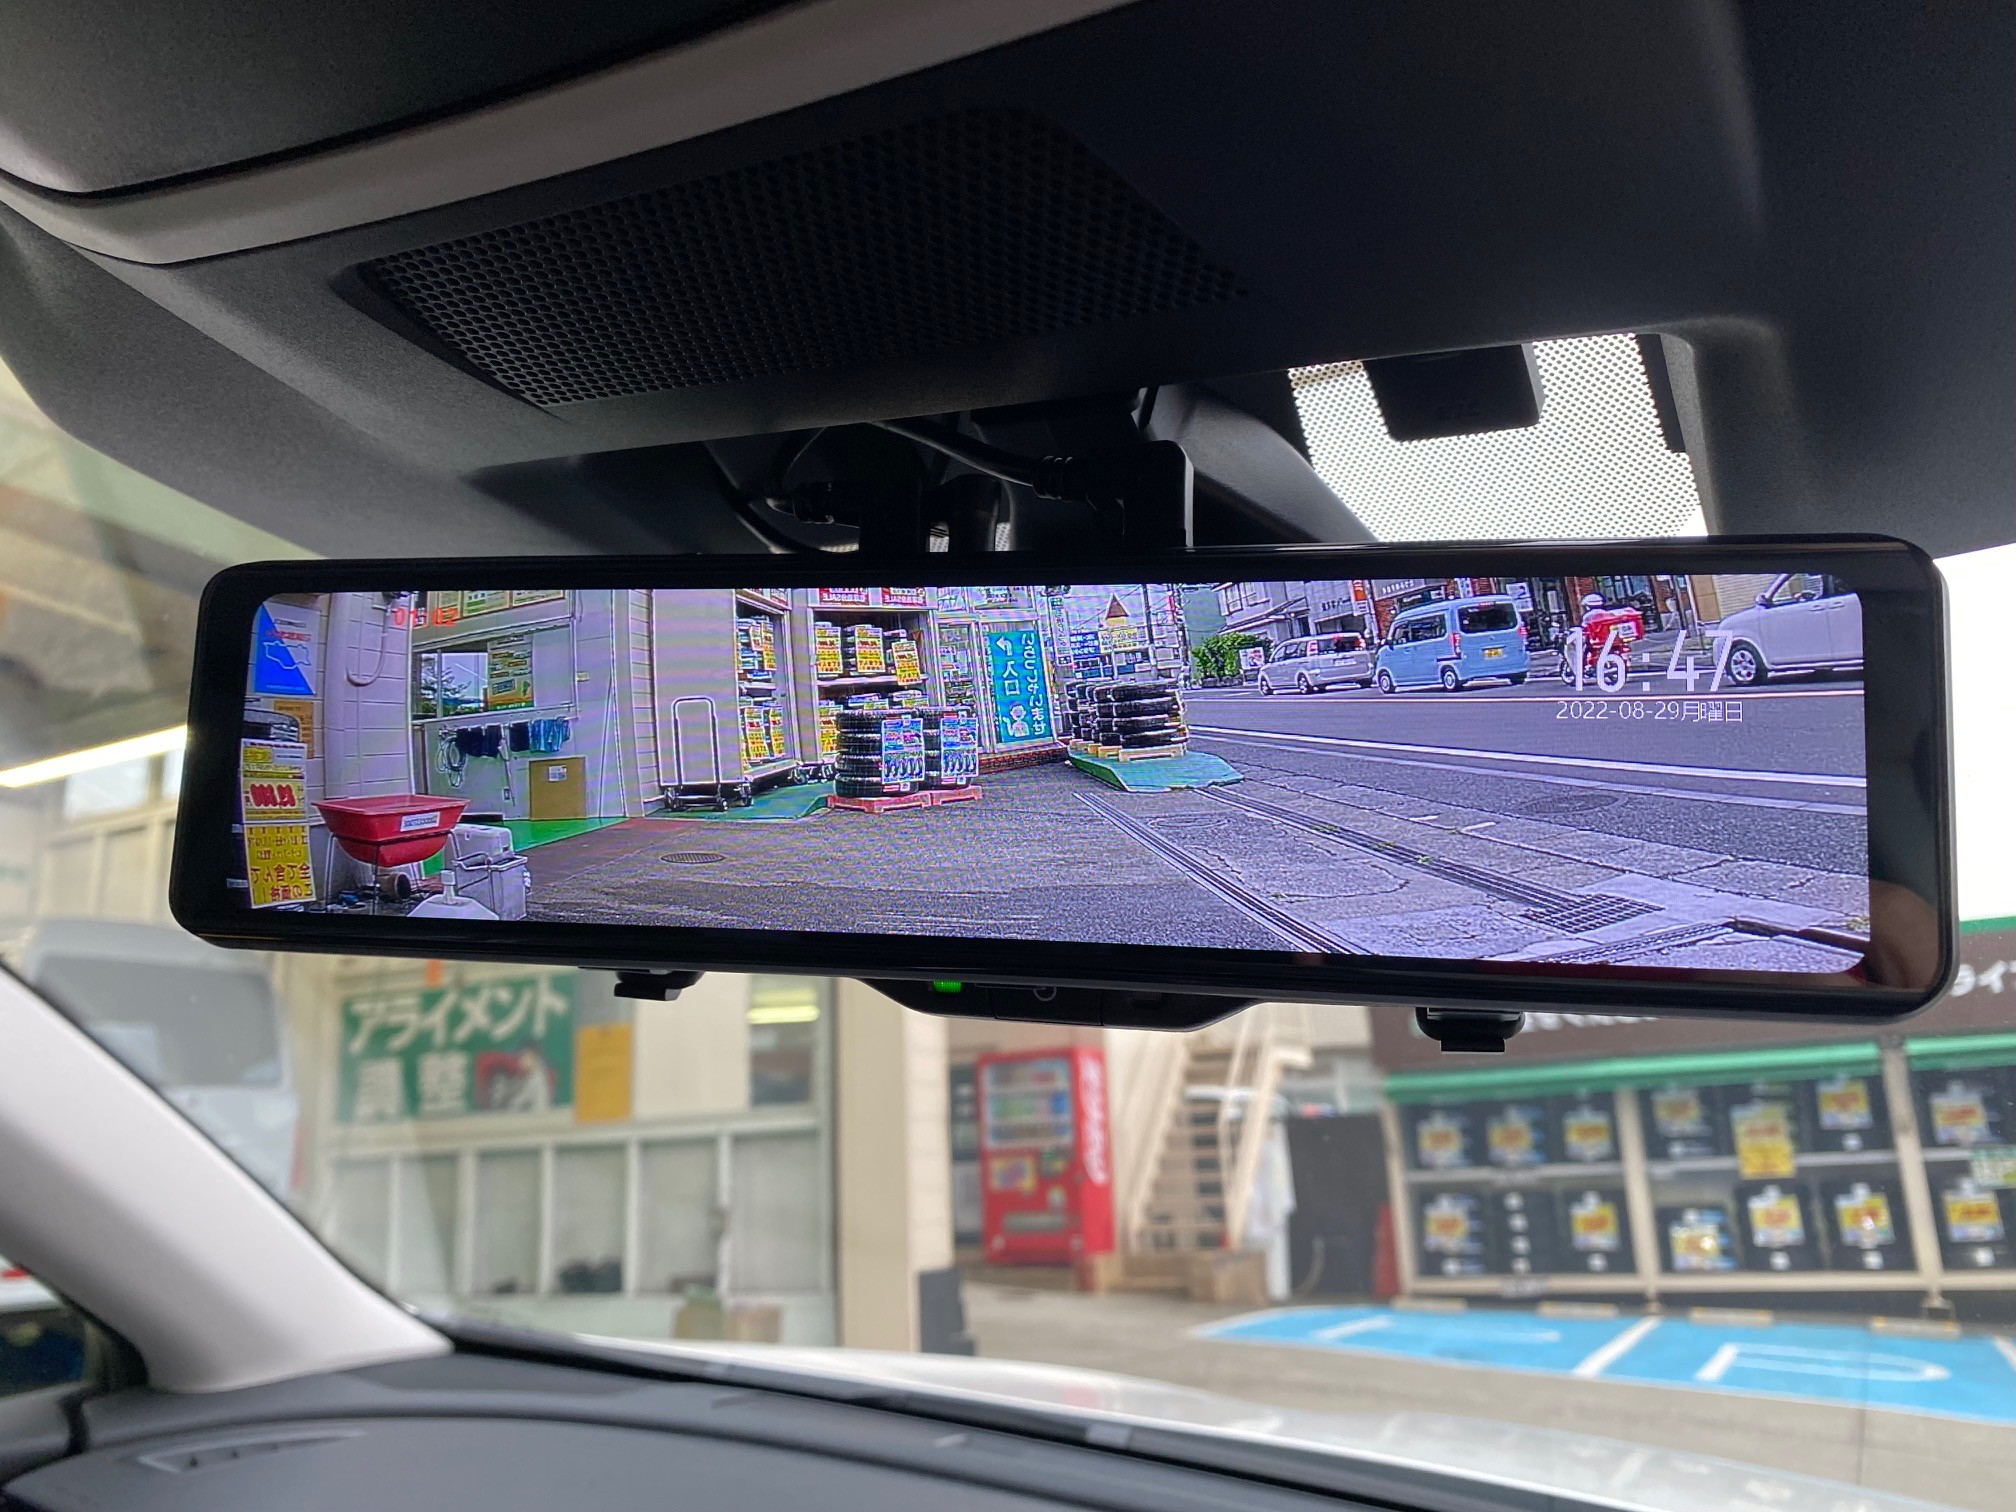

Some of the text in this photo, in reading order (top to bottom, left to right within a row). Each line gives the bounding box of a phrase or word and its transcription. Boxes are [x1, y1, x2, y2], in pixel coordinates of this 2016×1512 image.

[1564, 628, 1733, 692] 16:47
[1556, 700, 1743, 723] 2022-08-29月曜日
[349, 973, 568, 1054] アライメント
